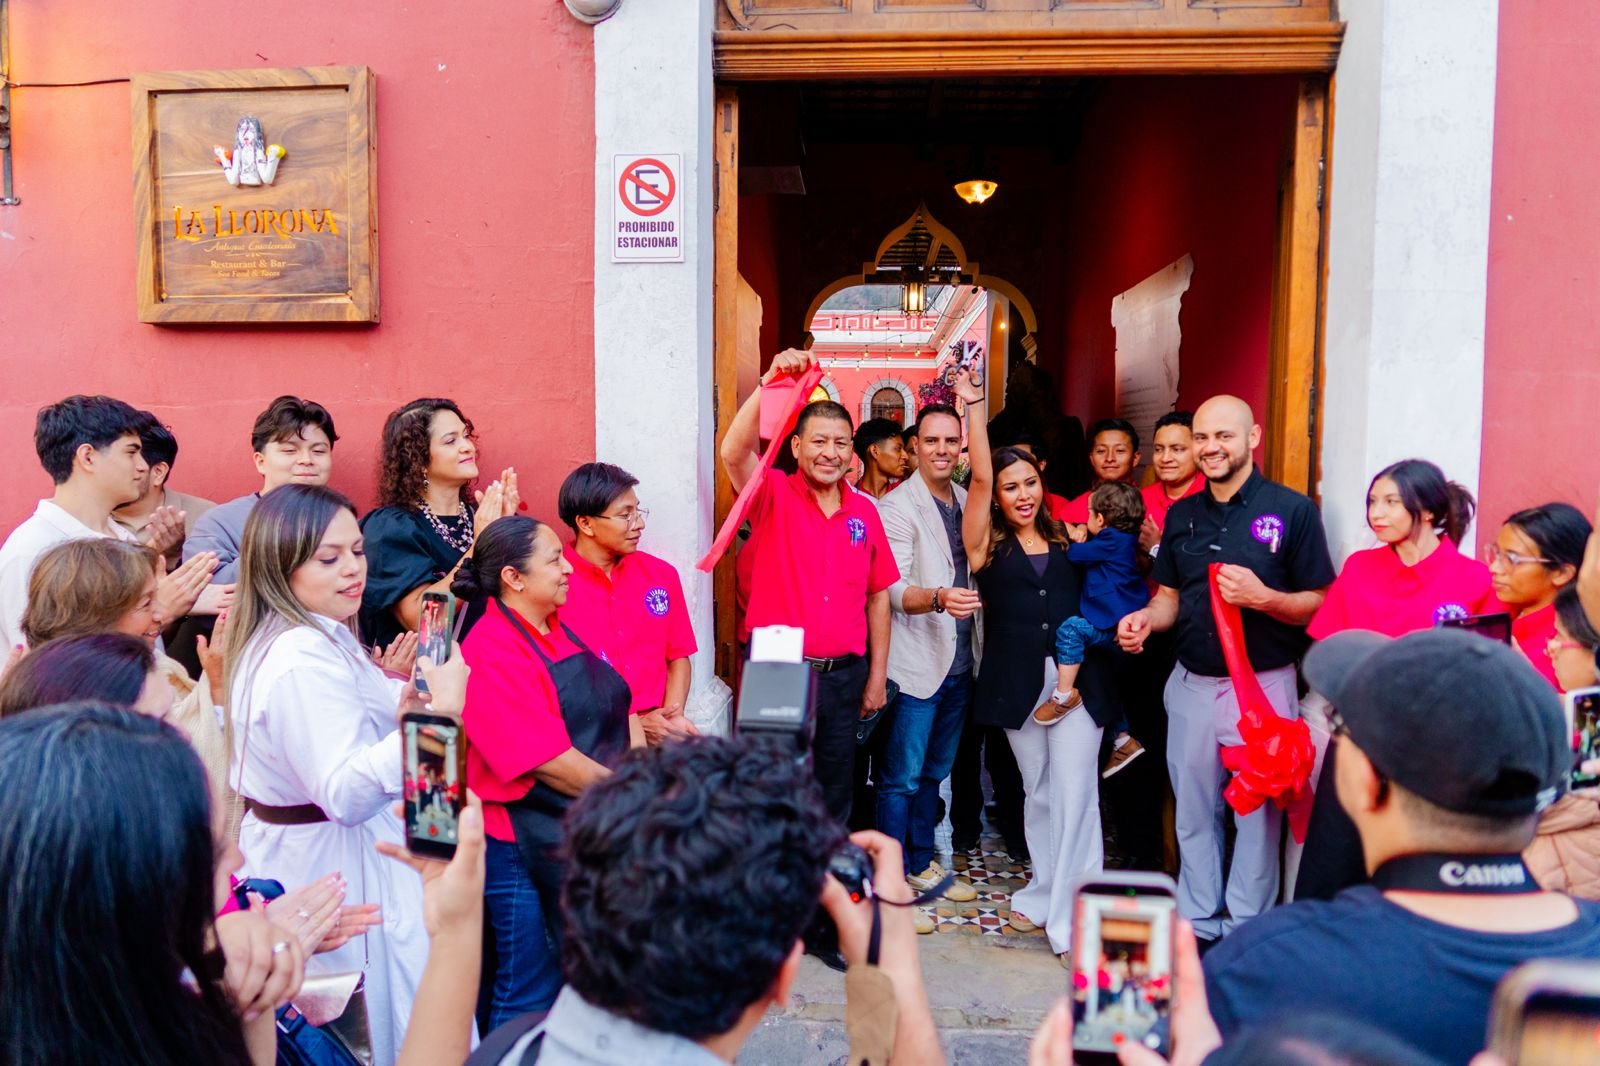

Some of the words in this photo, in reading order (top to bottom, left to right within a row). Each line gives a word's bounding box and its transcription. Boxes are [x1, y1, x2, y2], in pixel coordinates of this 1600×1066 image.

[173, 205, 207, 241] LA
[213, 204, 340, 239] LLORONA
[618, 221, 674, 232] PROHIBIDO
[617, 236, 678, 248] ESTACIONAR
[210, 260, 256, 268] Restaurant
[259, 259, 267, 268] &
[270, 259, 286, 267] Bar
[1439, 861, 1525, 887] Canon
